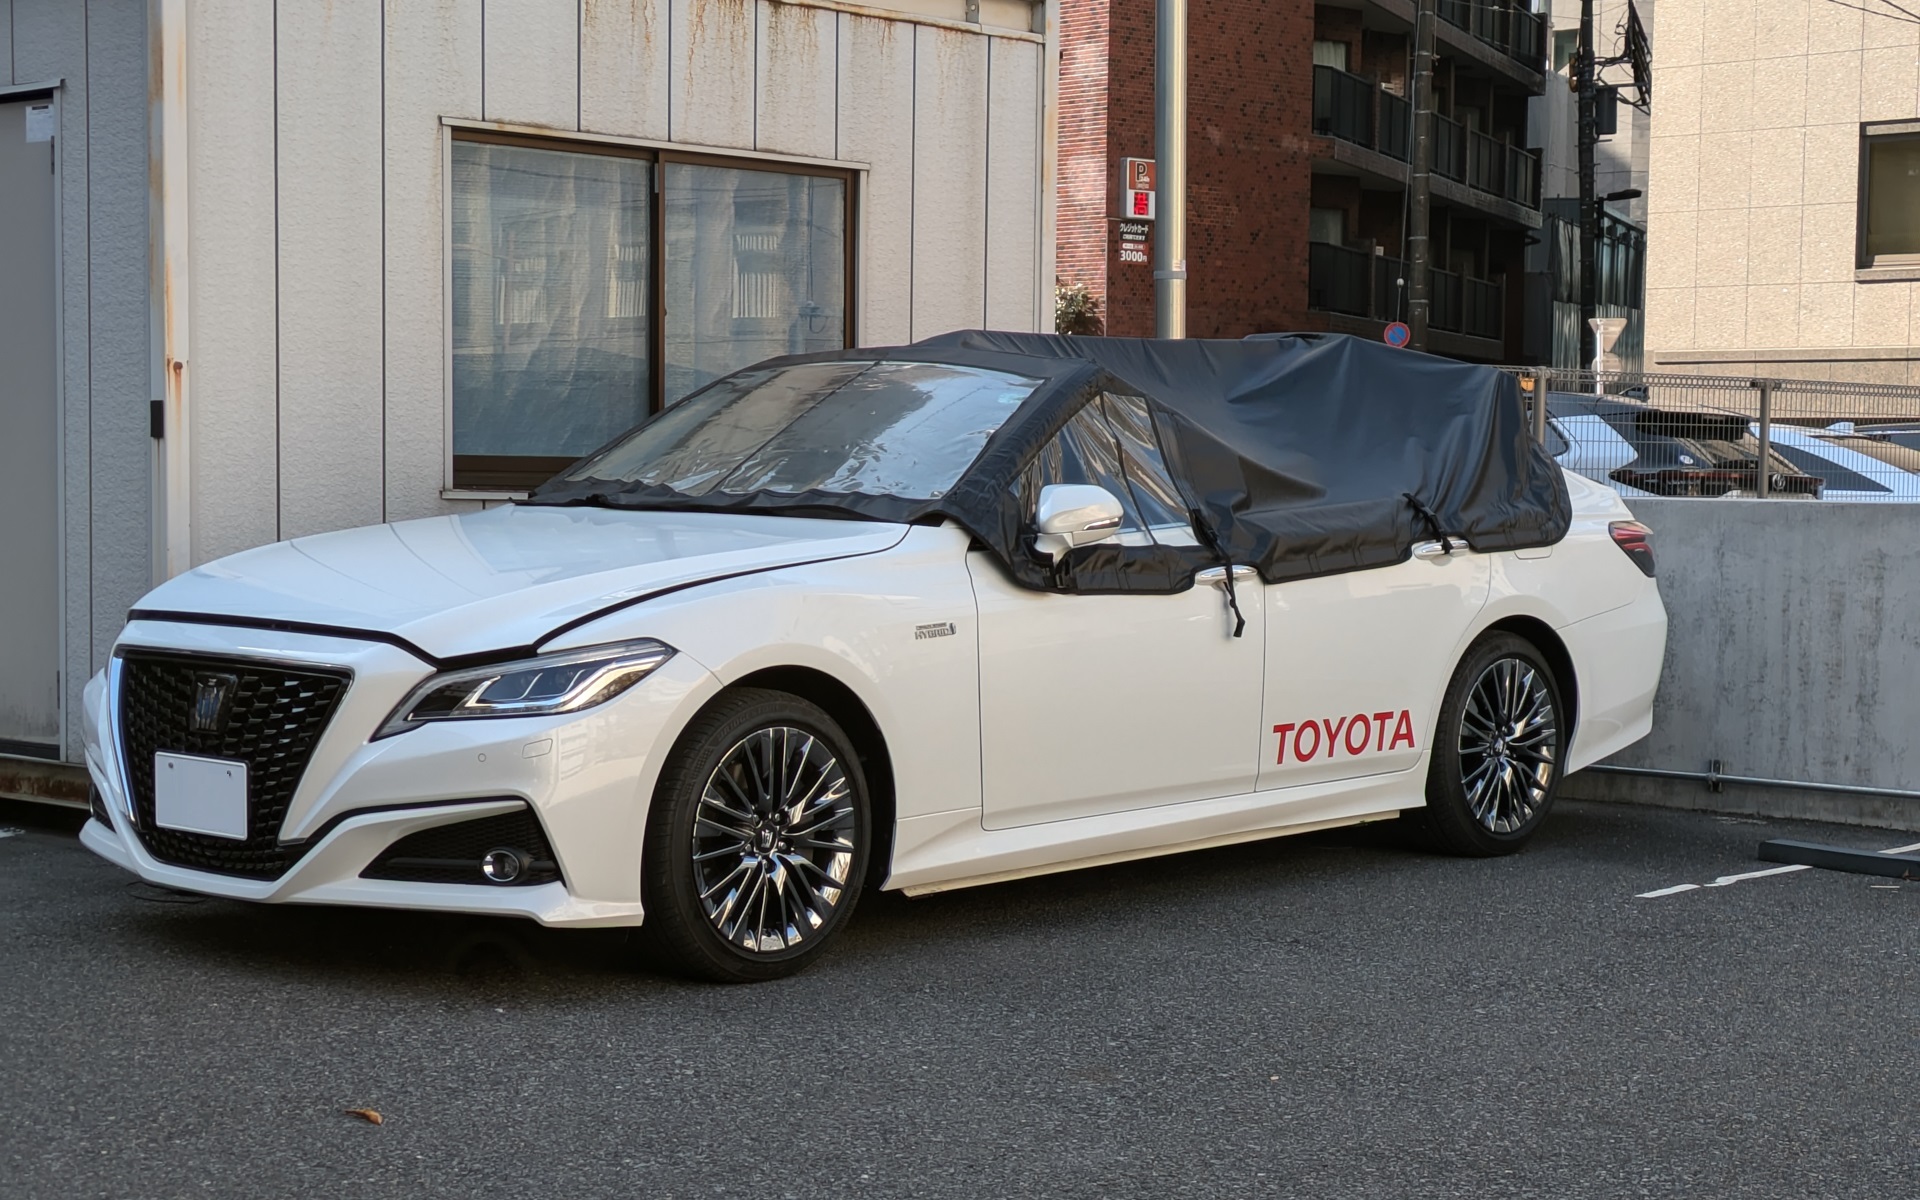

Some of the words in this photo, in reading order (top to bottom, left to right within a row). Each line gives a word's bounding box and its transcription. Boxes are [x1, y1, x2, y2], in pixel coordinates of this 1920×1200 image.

[1136, 162, 1148, 182] P
[914, 627, 949, 640] HYBRID
[1273, 709, 1415, 765] TOYOTA
